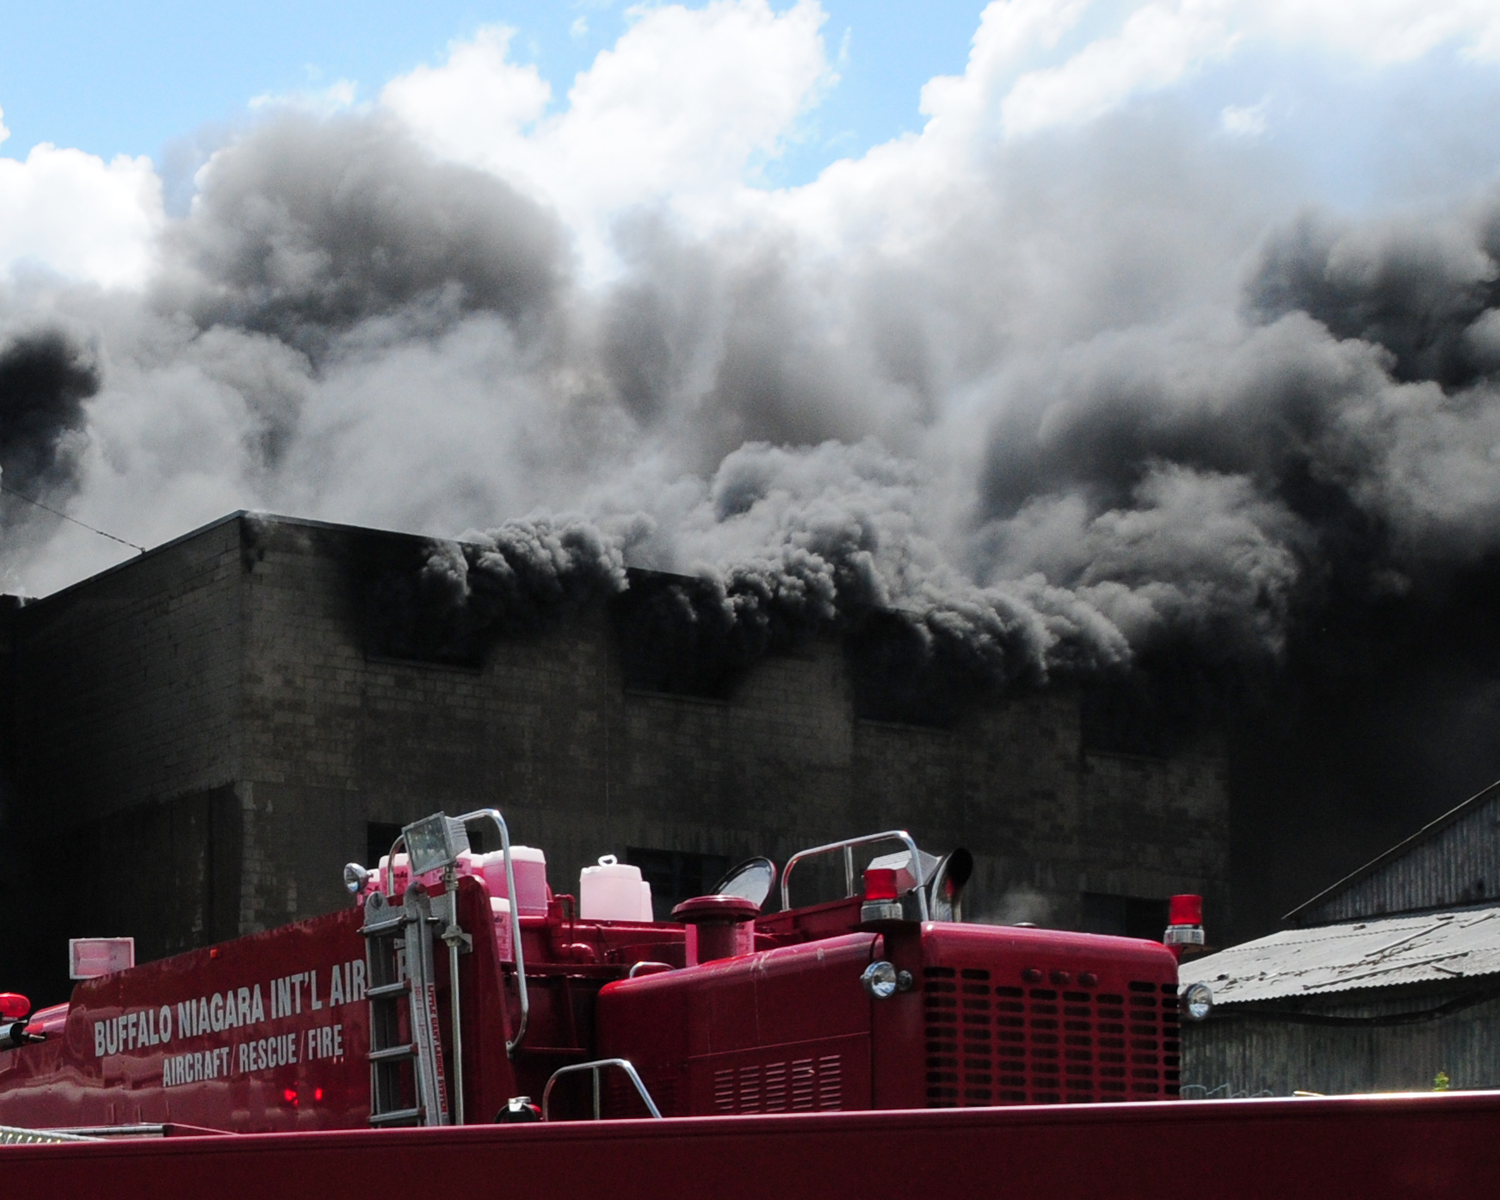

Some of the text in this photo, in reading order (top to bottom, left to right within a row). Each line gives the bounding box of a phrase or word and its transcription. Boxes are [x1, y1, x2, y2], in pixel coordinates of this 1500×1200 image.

[94, 1005, 172, 1057] BUFFALO
[177, 984, 265, 1039] NIAGARA
[270, 970, 322, 1020] INT'L
[162, 1046, 229, 1088] AIRCRAFT
[239, 1033, 297, 1073] RESCUE
[308, 1024, 343, 1060] FIRE
